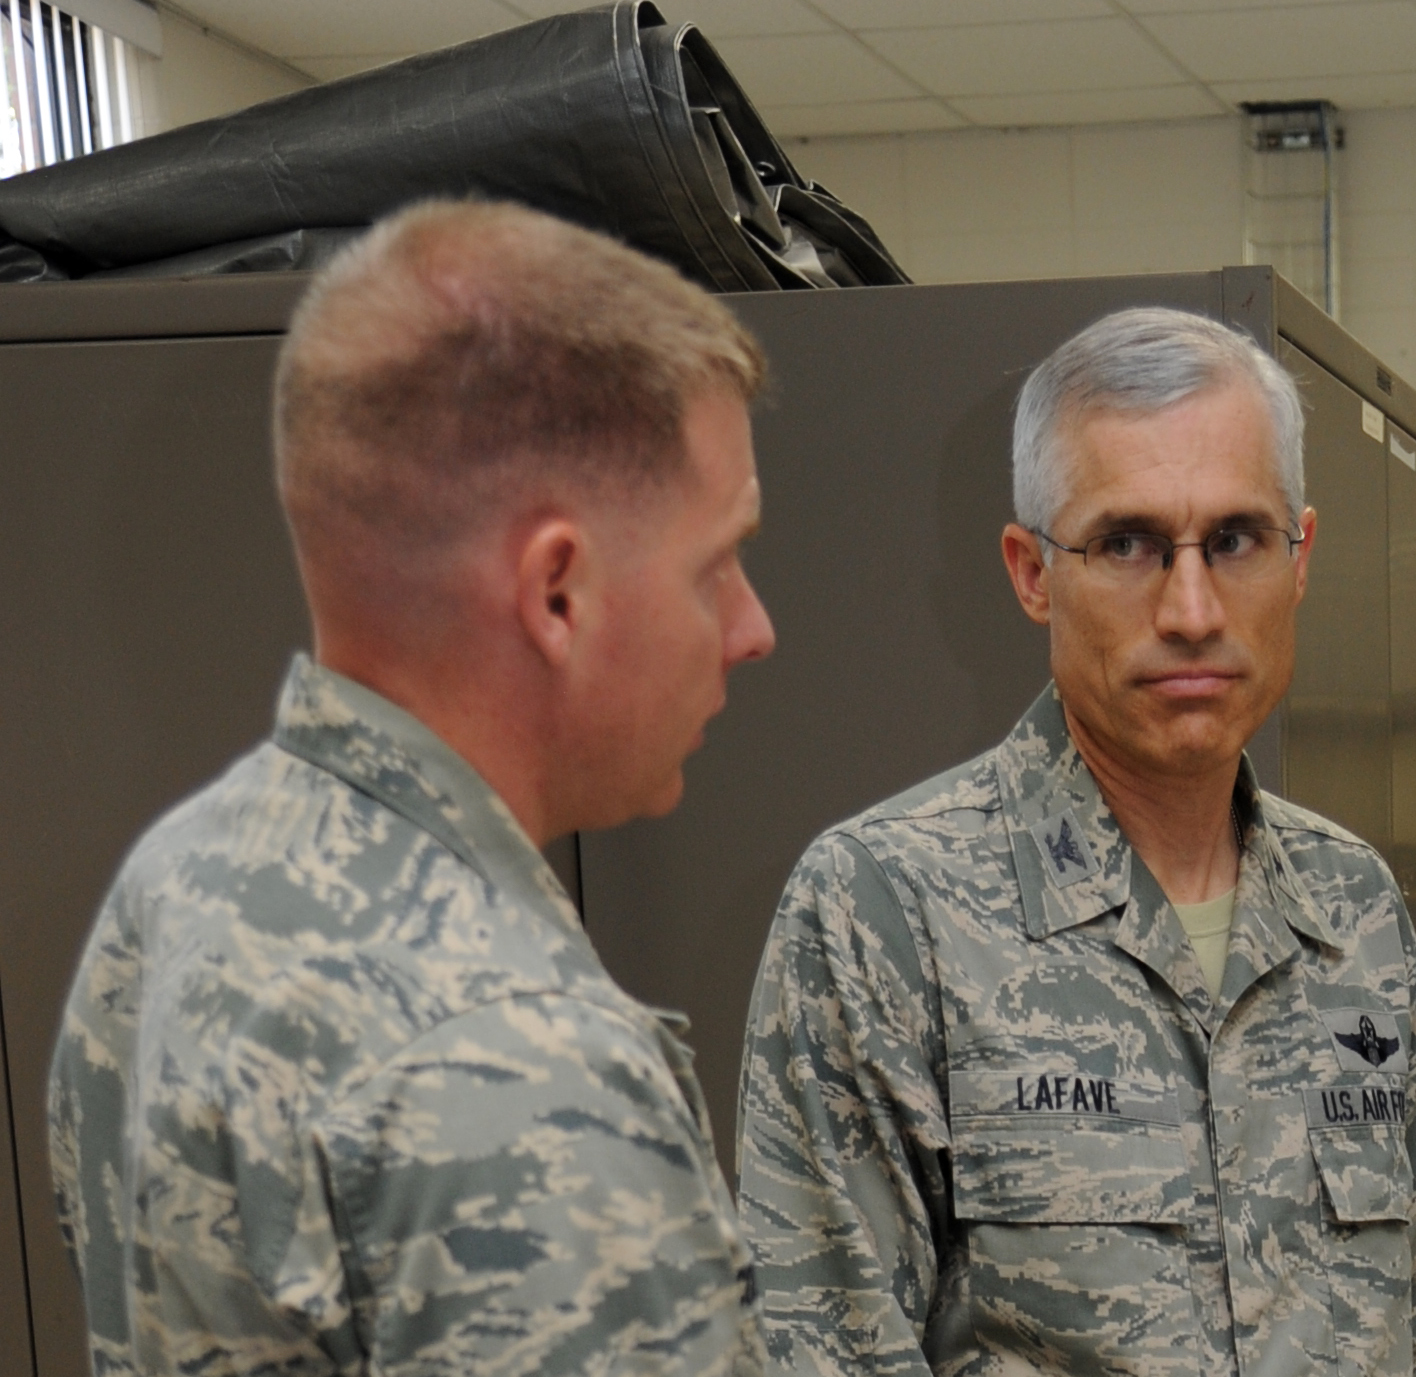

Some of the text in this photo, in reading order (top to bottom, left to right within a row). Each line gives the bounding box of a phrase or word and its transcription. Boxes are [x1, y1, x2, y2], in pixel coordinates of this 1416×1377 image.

[1016, 1074, 1121, 1115] LAFAVE
[1321, 1090, 1360, 1123] U.S.
[1361, 1088, 1392, 1121] AIR
